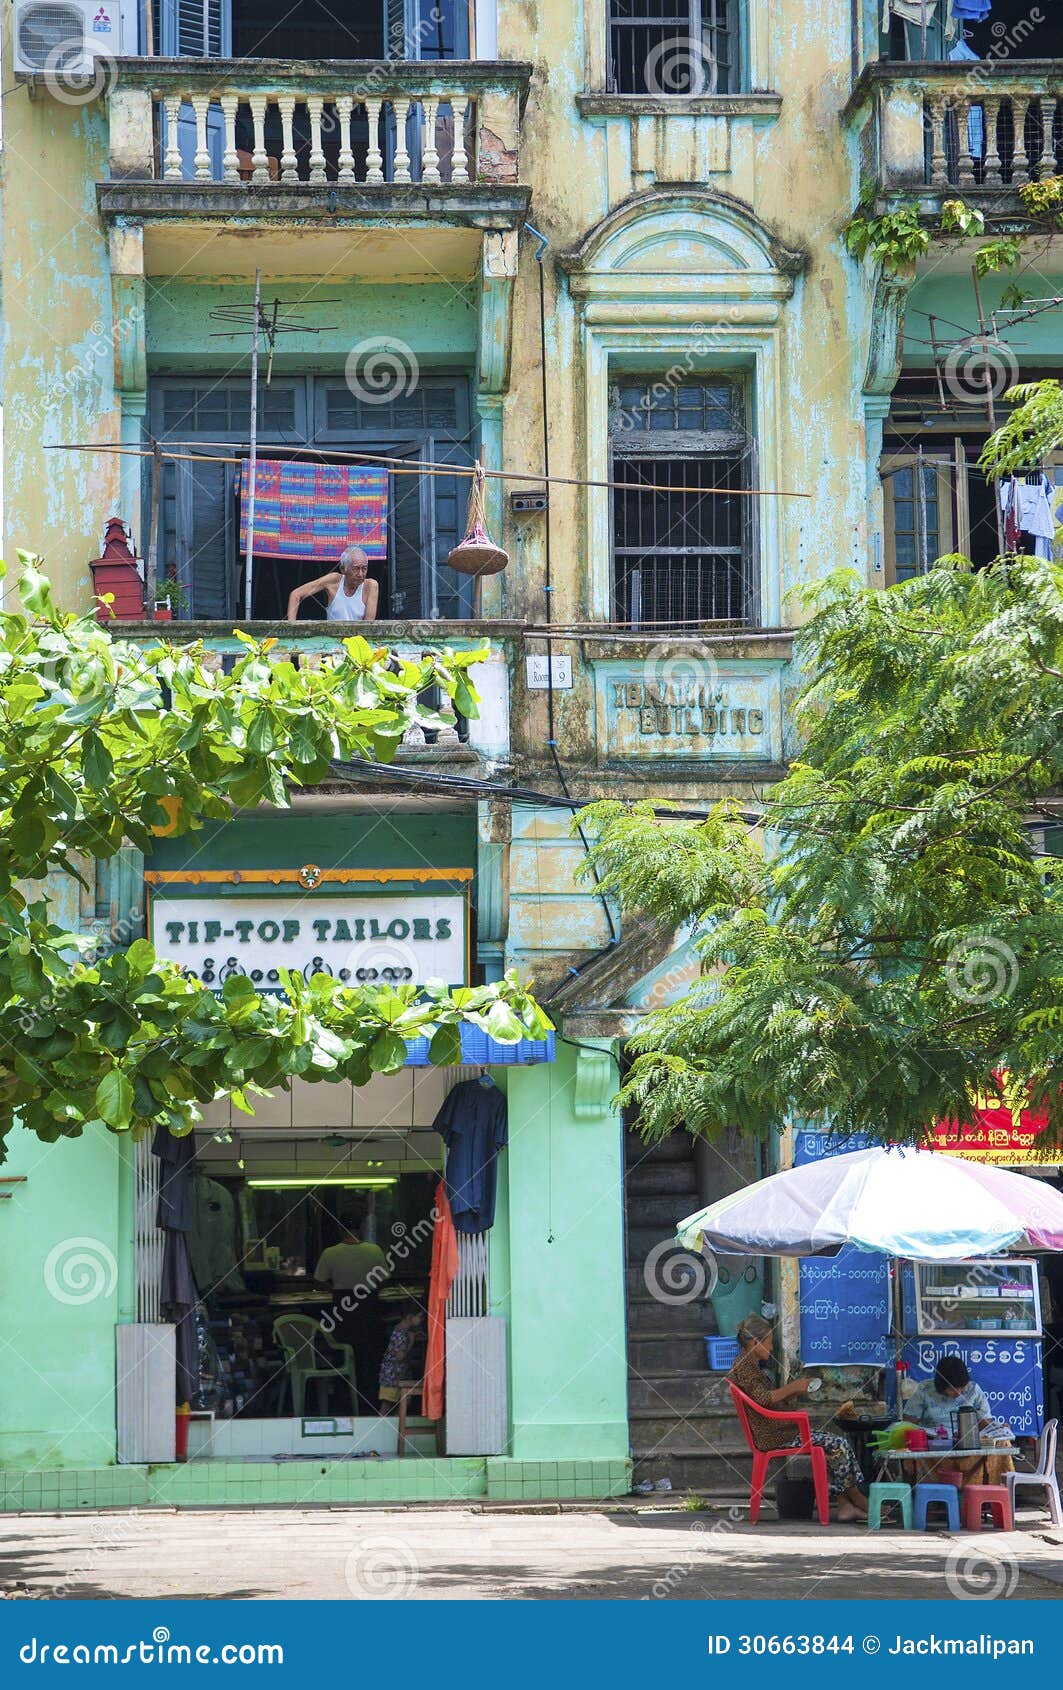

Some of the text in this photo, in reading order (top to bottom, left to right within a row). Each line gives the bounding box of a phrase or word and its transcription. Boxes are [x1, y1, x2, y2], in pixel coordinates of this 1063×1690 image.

[639, 708, 764, 735] BUILDING
[165, 917, 452, 944] TIP-TOP TAILORS
